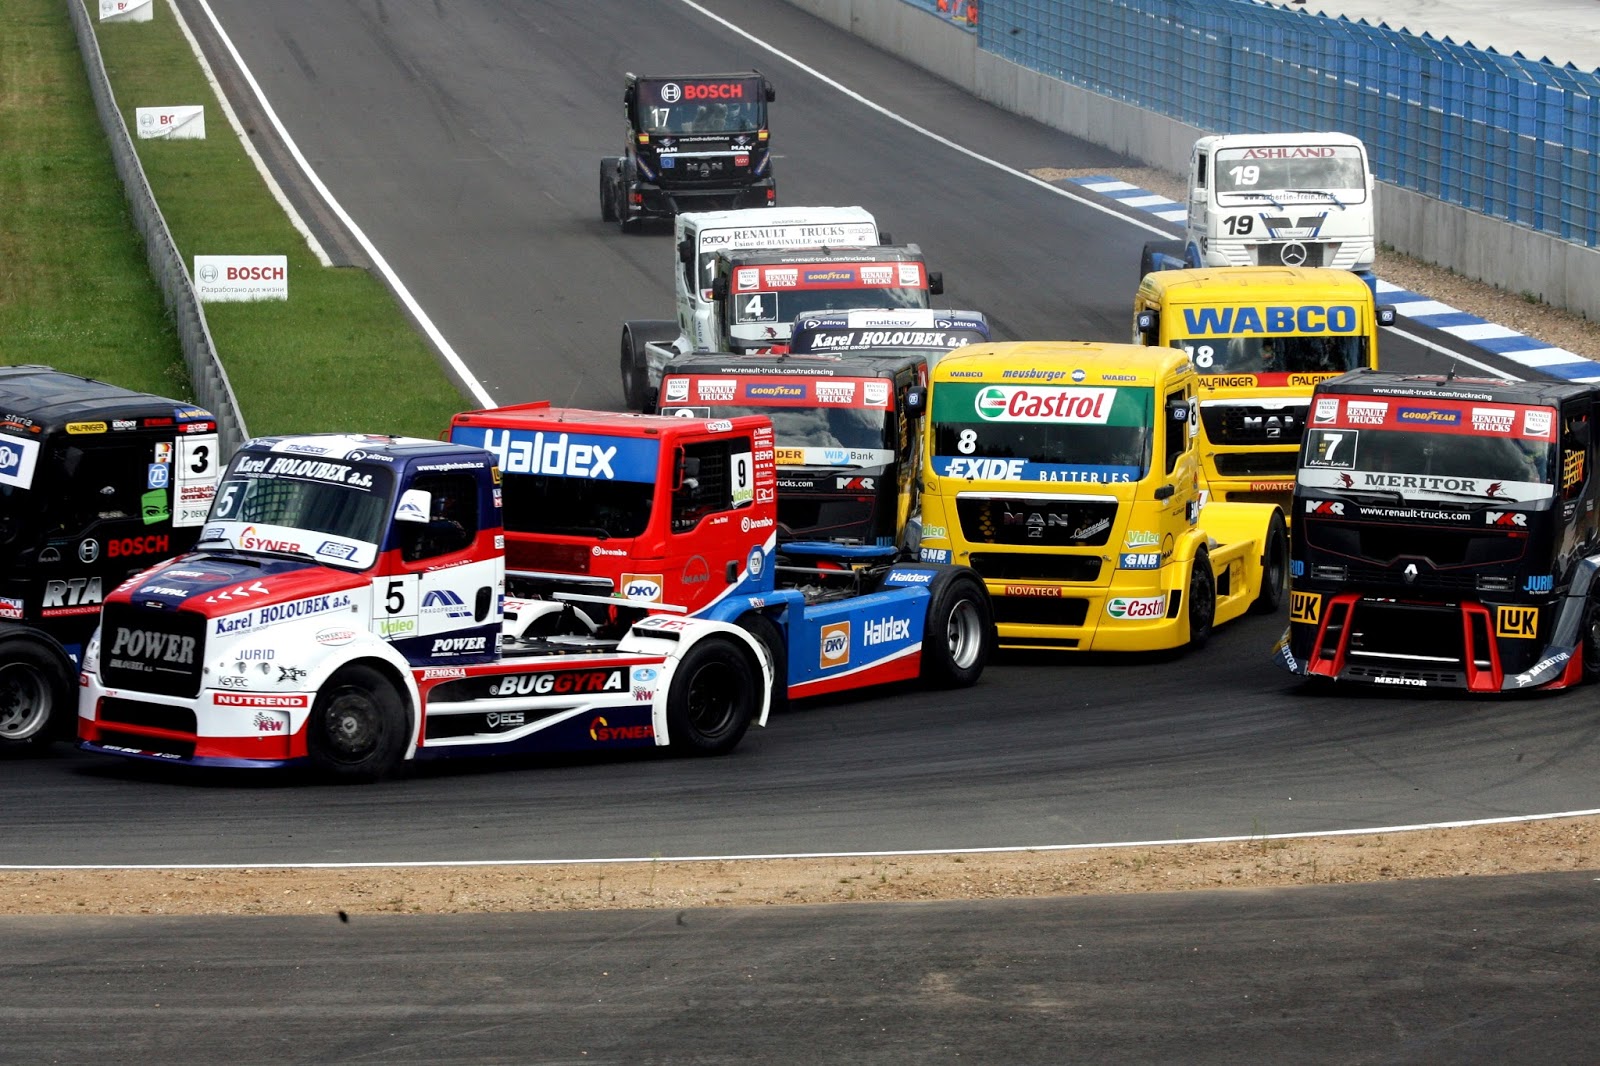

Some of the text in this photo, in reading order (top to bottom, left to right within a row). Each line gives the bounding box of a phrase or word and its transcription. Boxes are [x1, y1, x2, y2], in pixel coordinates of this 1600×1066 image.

[684, 84, 743, 99] BOSCH
[651, 108, 670, 127] 17
[1242, 148, 1336, 159] ASHLAND
[687, 162, 723, 171] MAN
[1229, 166, 1260, 186] 19
[1223, 215, 1254, 235] 19
[734, 229, 786, 240] RENAULT
[800, 227, 845, 237] TRUCKS
[227, 267, 284, 280] BOSCH
[765, 274, 798, 282] RENAULT
[807, 271, 851, 280] GOODYEAR
[745, 295, 764, 316] 4
[866, 319, 913, 327] multicar
[1183, 306, 1355, 334] WABCO
[811, 332, 970, 347] Karel HOLOUBEK a.s.
[1185, 345, 1214, 368] 18
[721, 367, 834, 376] www.renault-trucks.com/truckracing
[1002, 368, 1066, 382] meusburger
[698, 386, 736, 395] RENAULT
[751, 386, 801, 396] GOODYEAR
[816, 387, 855, 397] RENAULT
[1373, 387, 1492, 401] www.renault-trucks.com/truckracing
[818, 395, 852, 404] TRUCKS
[1008, 390, 1105, 418] Castrol
[1346, 407, 1388, 418] RENAULT
[1402, 411, 1456, 421] GOODYEAR
[5, 413, 33, 427] styria
[1244, 416, 1294, 428] MAN
[1348, 415, 1384, 424] TRUCKS
[1471, 414, 1515, 425] RENAULT
[68, 423, 105, 432] PALFINGER
[1473, 422, 1511, 432] TRUCKS
[957, 429, 978, 454] 8
[1323, 434, 1343, 460] 7
[191, 445, 209, 473] 3
[367, 453, 394, 462] altron
[484, 429, 617, 479] Haldex
[825, 451, 873, 460] WIR Bank
[151, 469, 165, 482] ZF
[234, 456, 373, 487] Karel HOLOUBEK a.s.
[738, 459, 746, 487] 9
[948, 458, 1026, 480] EXIDE
[836, 477, 875, 489] MKR
[1040, 471, 1131, 483] BATTERIES
[1365, 473, 1476, 493] MERITOR
[216, 486, 239, 517] 5
[1305, 501, 1345, 516] MKR
[1360, 507, 1471, 521] www.renault-trucks.com
[750, 517, 773, 529] brembo
[1003, 512, 1068, 526] MAN
[1486, 511, 1527, 527] MKR
[107, 534, 169, 557] BOSCH
[244, 538, 301, 553] SYNER
[601, 548, 627, 556] brembo
[920, 548, 947, 560] GNB
[1125, 554, 1158, 565] GNB
[889, 571, 932, 583] Haldex
[42, 577, 102, 607] RTA
[384, 580, 405, 614] 5
[628, 586, 658, 596] DKV
[1007, 586, 1059, 597] NOVATECK
[216, 594, 351, 634] Karel HOLOUBEK a.s.
[420, 605, 468, 614] PRAGOPROJEKT
[380, 619, 414, 634] Valeo
[864, 616, 910, 646] Haldex
[111, 627, 196, 664] POWER
[432, 637, 486, 652] POWER
[824, 637, 847, 653] DKV
[235, 649, 274, 661] JURID
[1528, 652, 1570, 676] MERITOR
[422, 668, 466, 680] REMOSKA
[498, 671, 622, 695] BUGGYRA
[1374, 676, 1427, 687] MERITOR
[217, 695, 303, 706] NUTREND
[500, 713, 525, 723] ECS
[259, 720, 284, 731] KW
